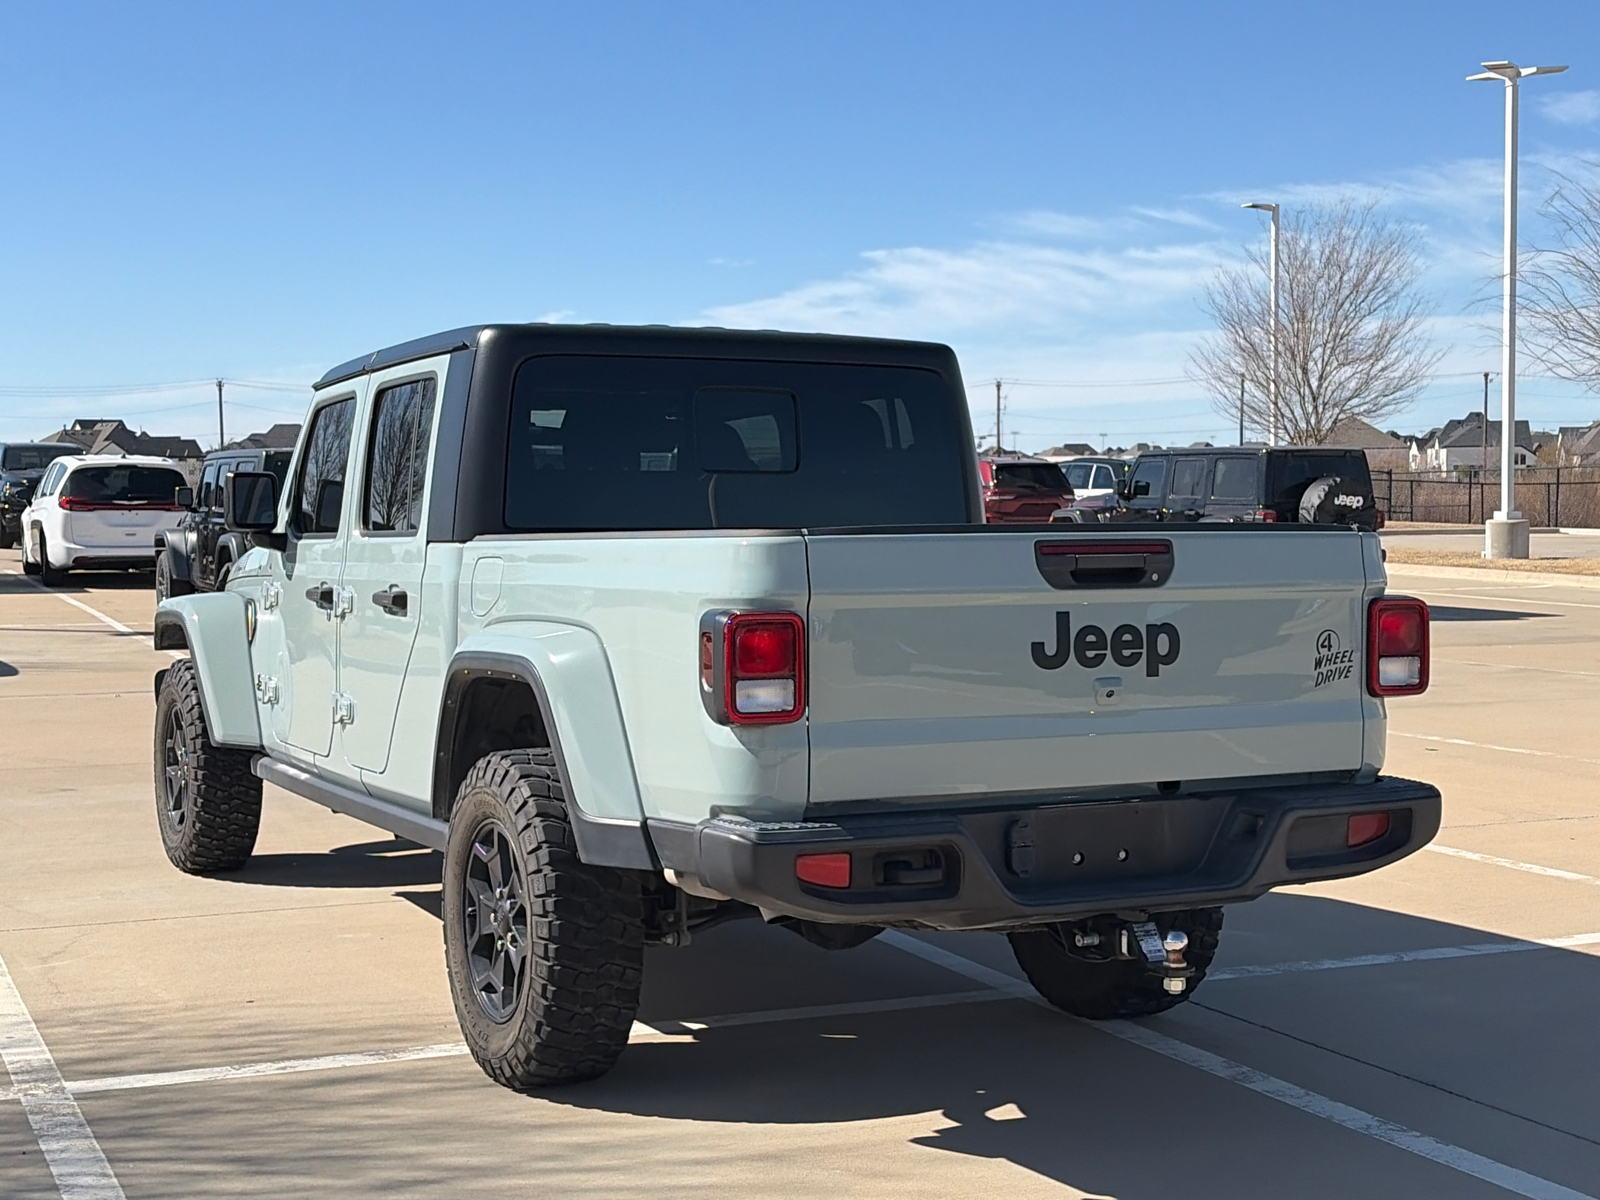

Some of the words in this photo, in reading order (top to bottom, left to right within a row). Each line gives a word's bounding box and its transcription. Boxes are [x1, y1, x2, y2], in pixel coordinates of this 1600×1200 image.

[1334, 492, 1364, 509] Jeep
[1031, 611, 1180, 677] Jeep
[1314, 650, 1354, 671] WHEEL
[1314, 665, 1353, 688] DRIVE
